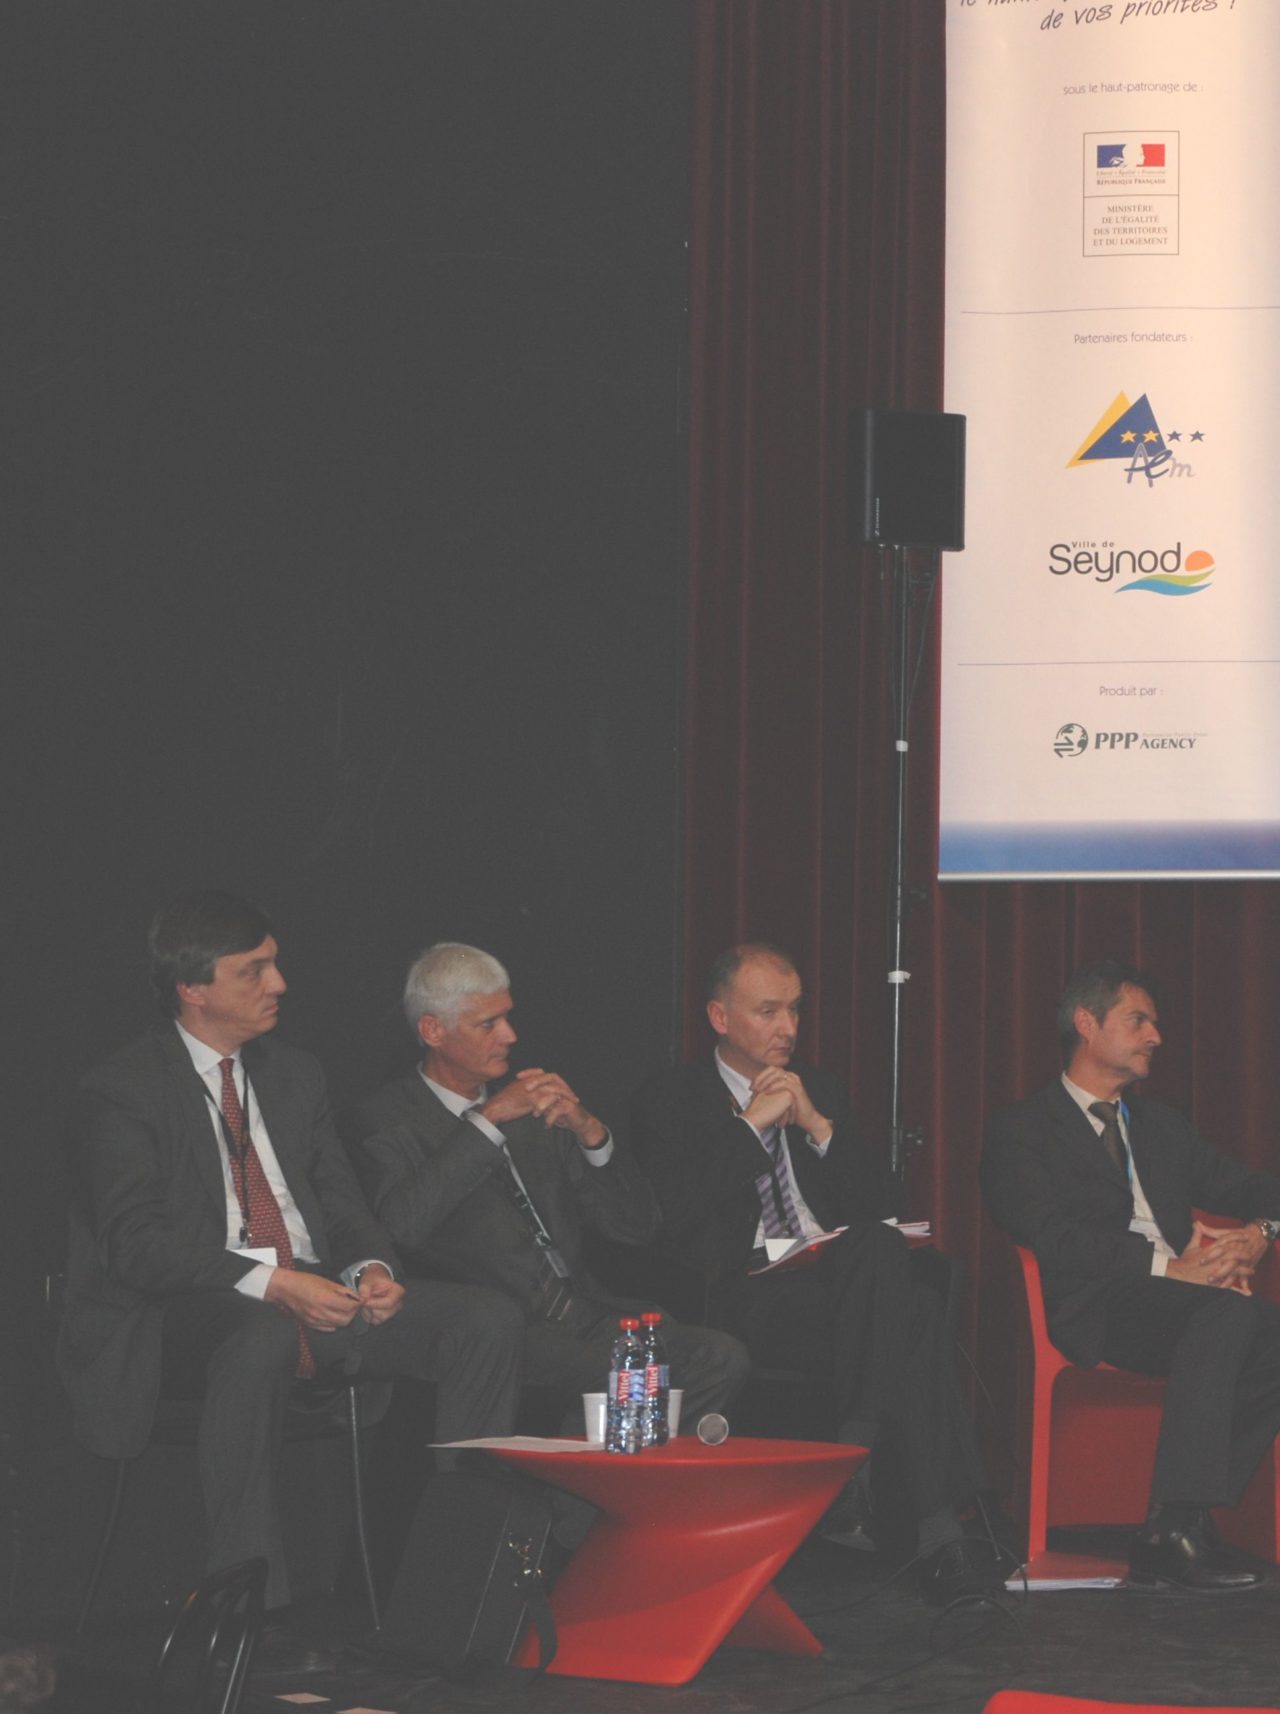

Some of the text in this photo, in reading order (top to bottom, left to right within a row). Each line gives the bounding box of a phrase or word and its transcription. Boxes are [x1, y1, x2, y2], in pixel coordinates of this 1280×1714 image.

[1040, 9, 1062, 31] de
[1074, 5, 1112, 25] vos
[1064, 85, 1087, 95] sous
[1088, 83, 1098, 93] le
[1100, 82, 1180, 94] haut-patronage
[1183, 82, 1198, 92] de
[1107, 204, 1153, 213] MINISTÈRE
[1102, 216, 1114, 224] DE
[1094, 226, 1168, 236] DES TERRITOIRES
[1093, 237, 1168, 246] ET DU LOGEMENT
[1074, 333, 1128, 344] Partenaires
[1130, 331, 1187, 342] fondateurs
[1049, 541, 1182, 583] Seynod
[1099, 686, 1137, 696] Produit
[1140, 687, 1157, 697] par
[1094, 732, 1139, 750] PPP
[1140, 738, 1197, 750] AGENCY
[618, 1372, 630, 1400] Vittel
[647, 1367, 658, 1394] Vittel
